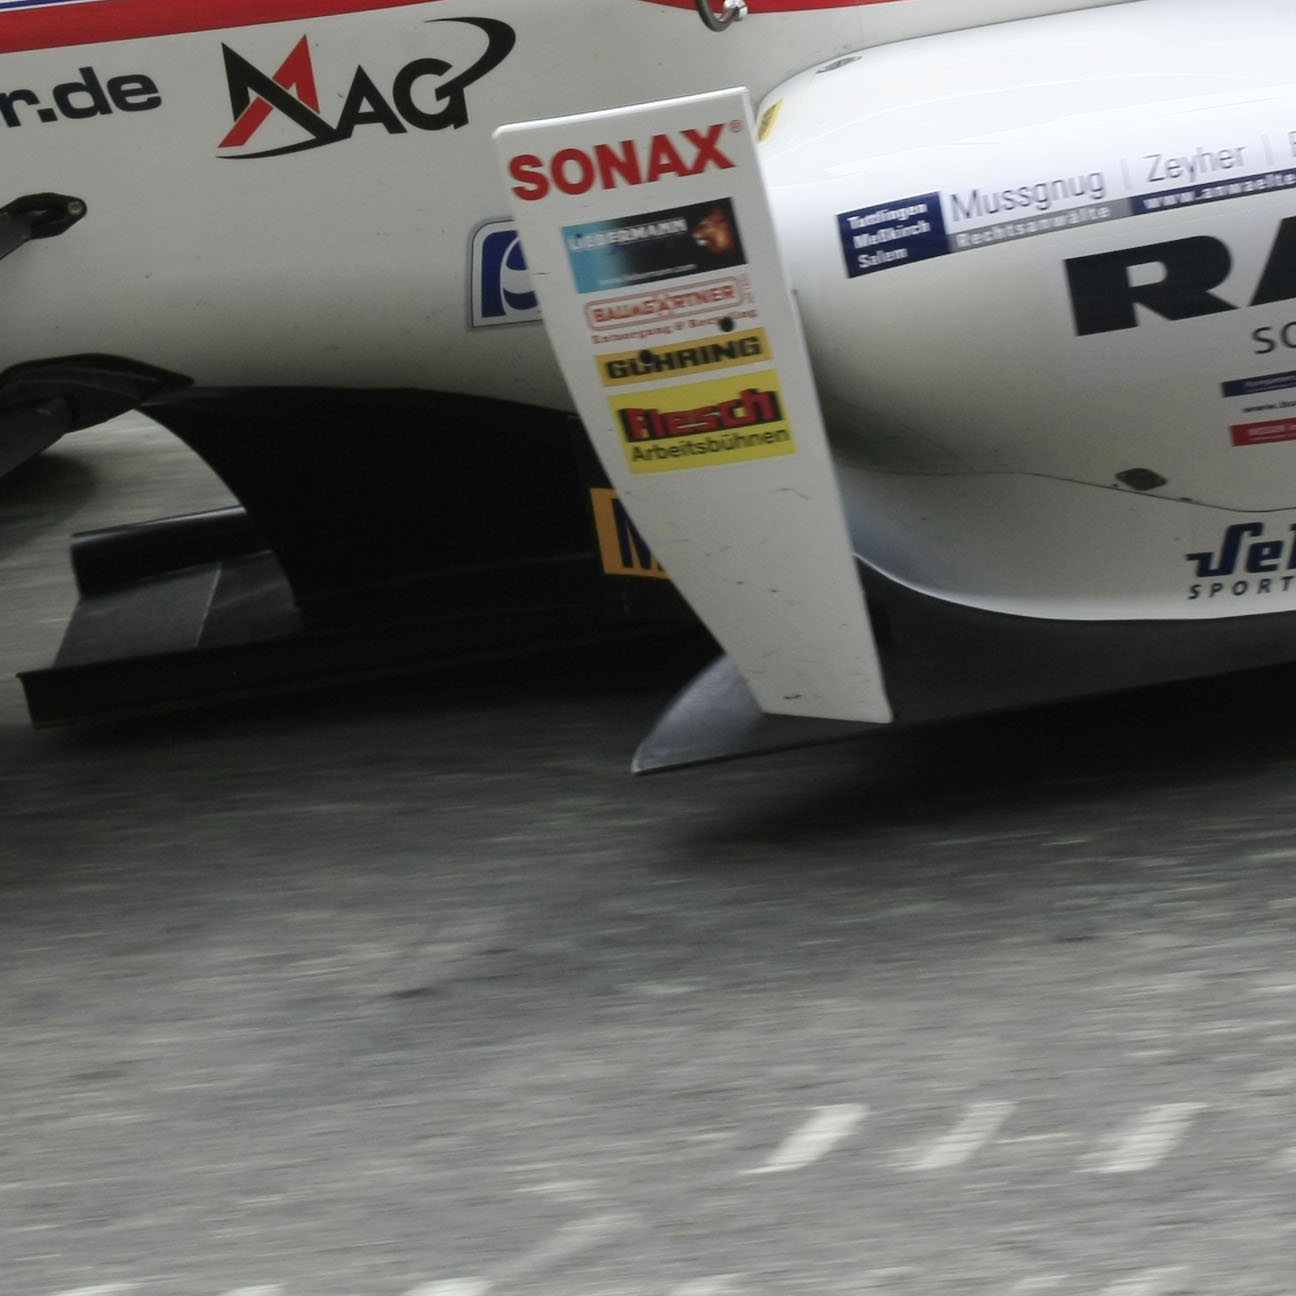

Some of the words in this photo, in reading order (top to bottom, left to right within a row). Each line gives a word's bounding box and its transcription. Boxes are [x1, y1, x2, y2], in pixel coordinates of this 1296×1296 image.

[508, 122, 737, 201] SONAX
[949, 171, 1106, 232] Mussgnug
[1143, 145, 1246, 184] Zeyher
[955, 206, 1112, 248] Rechtsanwälte
[632, 429, 791, 462] Arbeitsbühnen
